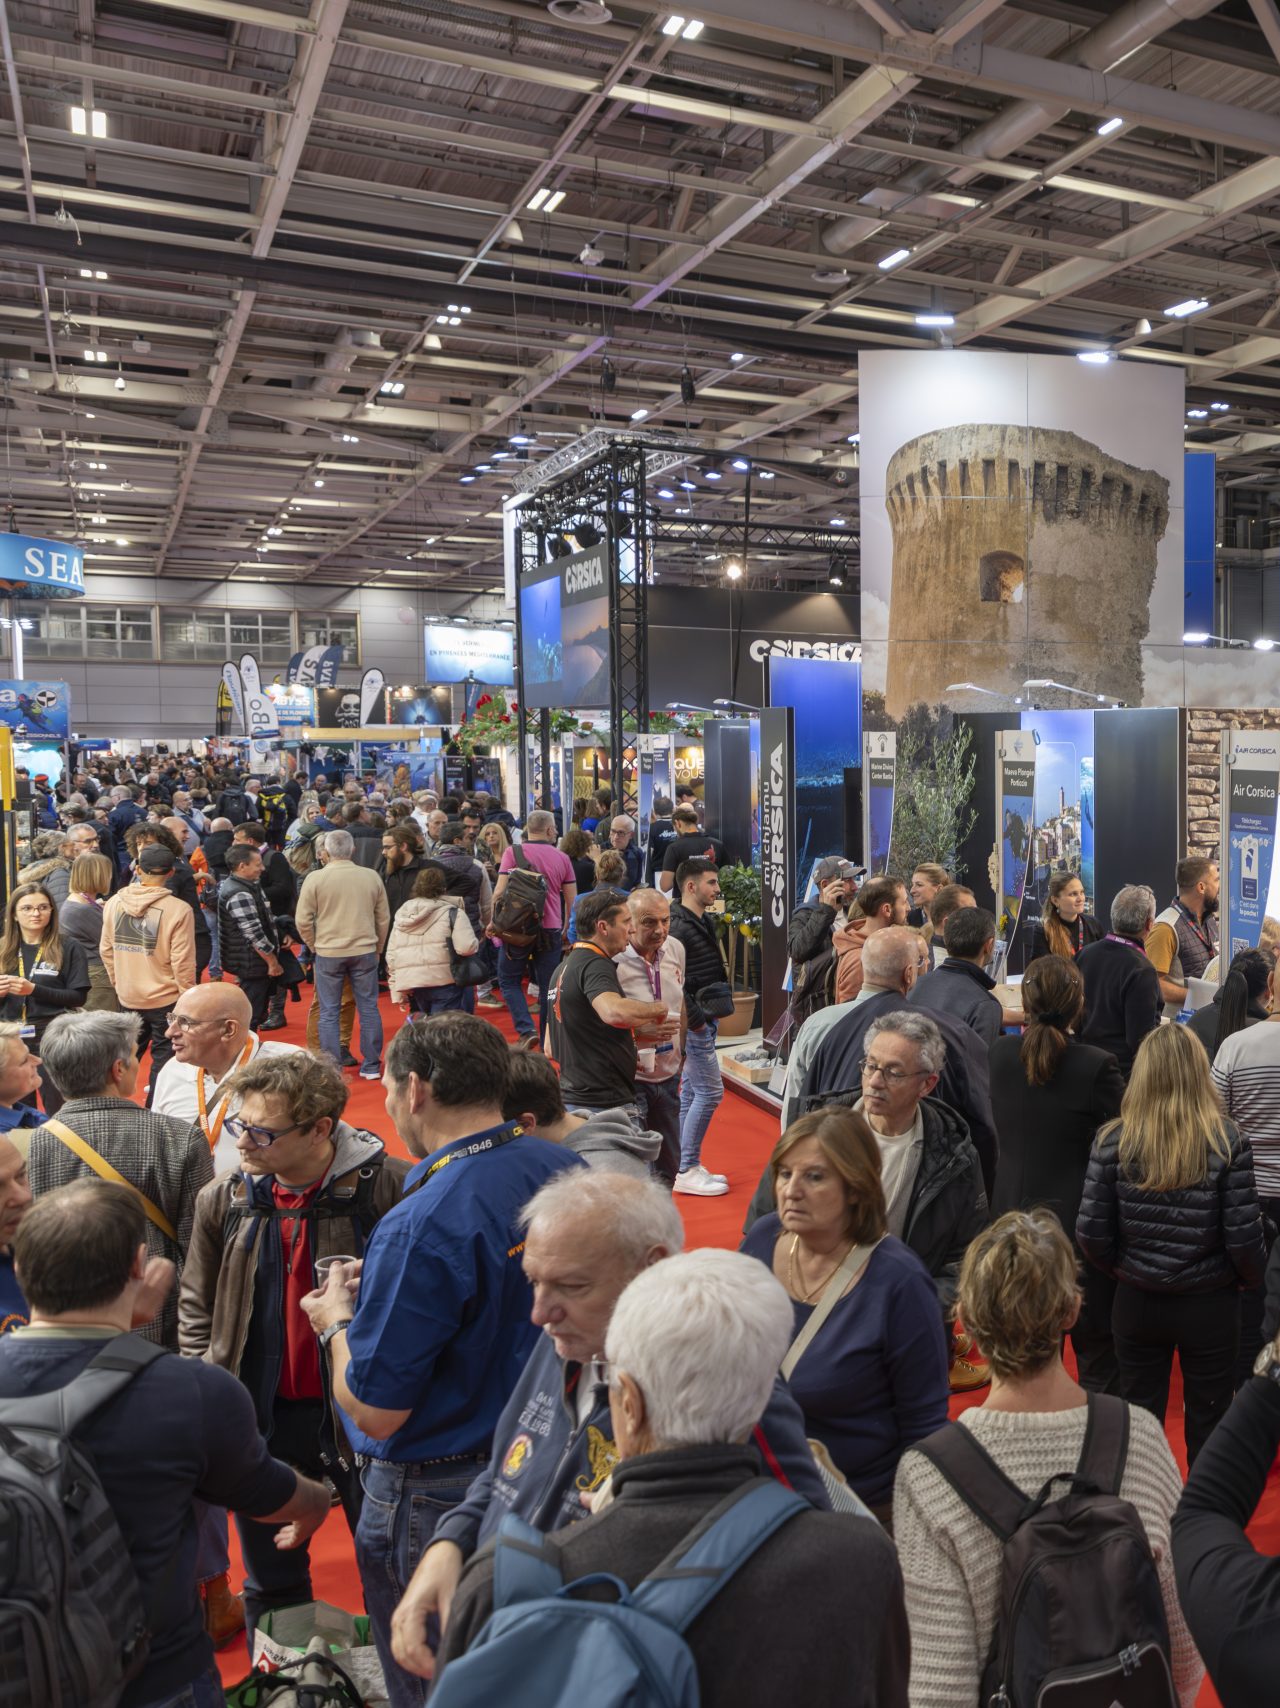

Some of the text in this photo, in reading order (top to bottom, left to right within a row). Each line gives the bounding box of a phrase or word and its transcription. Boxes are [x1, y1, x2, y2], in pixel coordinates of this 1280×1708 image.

[565, 556, 603, 594] CORSICA
[1249, 747, 1277, 755] CORSICA
[1004, 767, 1035, 778] Maeva Plongée
[1233, 783, 1275, 799] Air Corsica
[762, 781, 771, 886] mi chjamu
[770, 742, 785, 927] CORSICA
[467, 1139, 493, 1155] 1946
